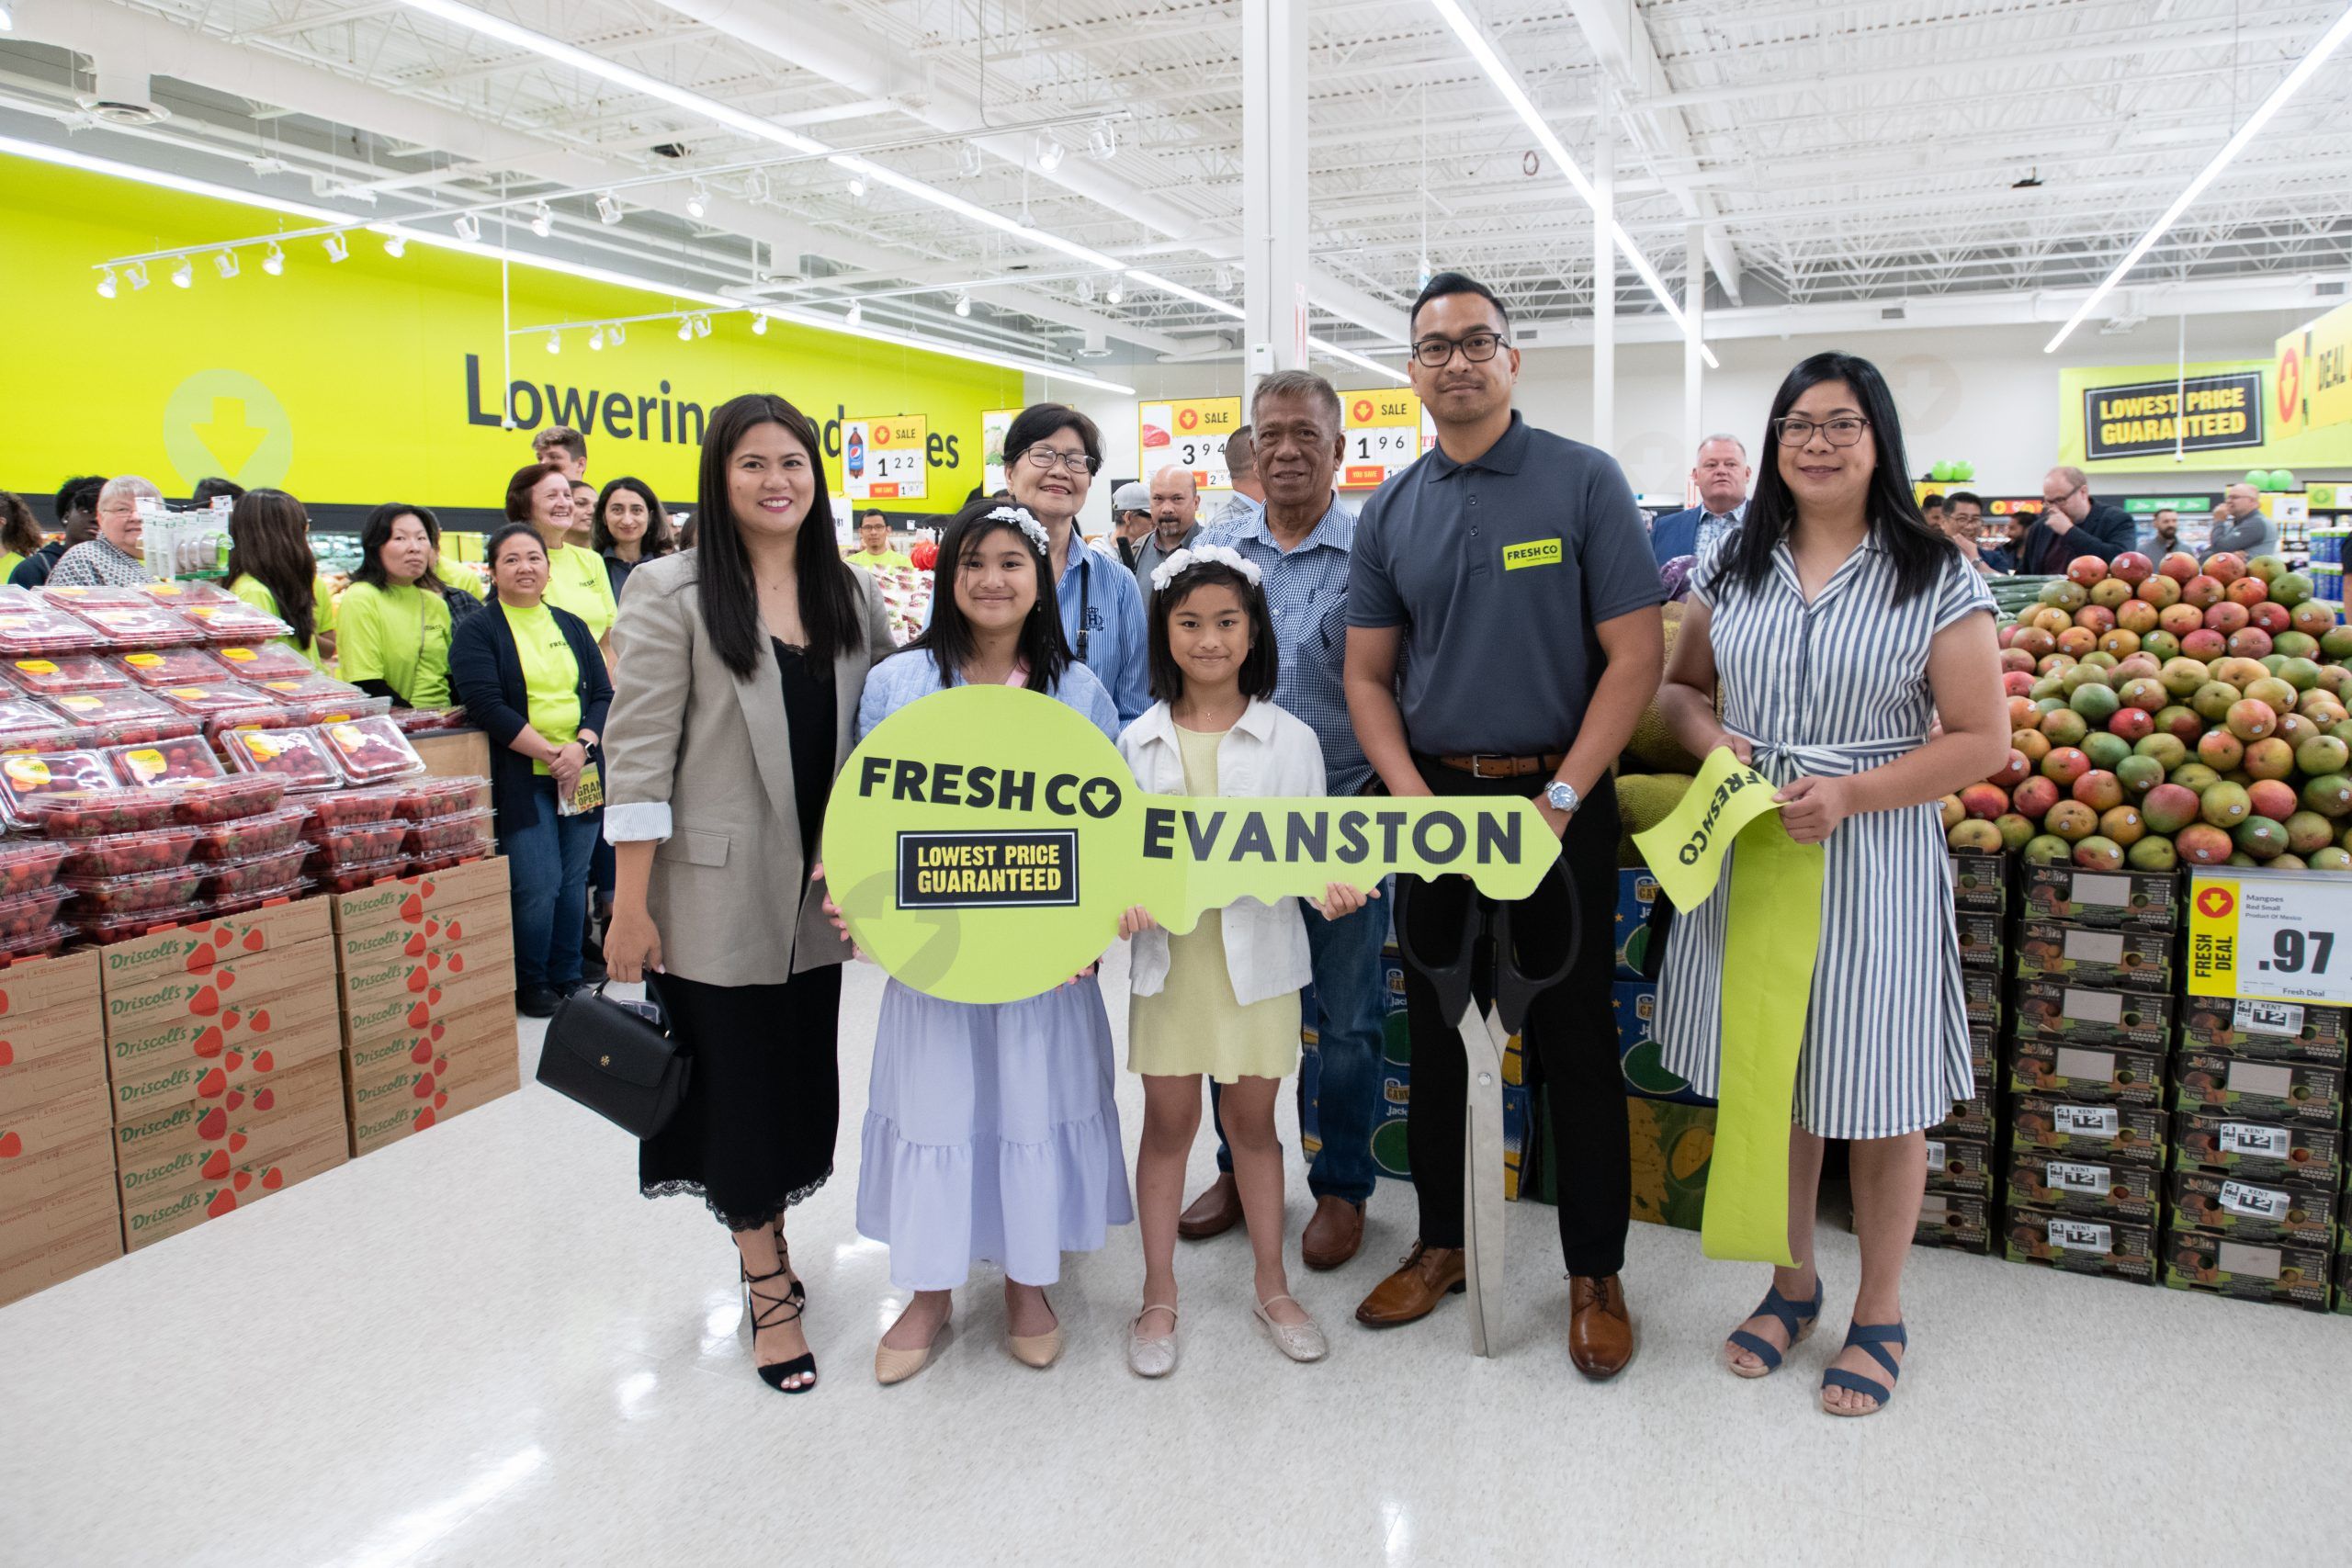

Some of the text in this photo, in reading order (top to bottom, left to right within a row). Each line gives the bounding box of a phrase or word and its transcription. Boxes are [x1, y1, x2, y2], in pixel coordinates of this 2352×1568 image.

[465, 353, 719, 446] Lowerin
[1382, 403, 1407, 415] SALE
[2099, 387, 2245, 420] LOWEST PRICE
[1205, 412, 1228, 423] SALE
[896, 429, 916, 439] SALE
[1143, 807, 1521, 864] EVANSTON
[918, 844, 1060, 867] LOWEST PRICE
[918, 868, 1061, 893] GUARANTEED
[343, 891, 395, 916] Driscoll's
[2245, 895, 2284, 903] Mangoes
[108, 940, 180, 969] Driscoll's
[347, 930, 399, 954] Driscoll's
[2215, 936, 2233, 971] DEAL
[2258, 929, 2335, 975] .97
[2195, 934, 2211, 977] FRESH
[349, 964, 401, 990] Driscoll's
[110, 985, 182, 1015] Driscoll's
[2282, 987, 2304, 996] Fresh
[353, 1001, 402, 1029] Driscoll's
[2255, 1010, 2285, 1024] 12
[2261, 1002, 2282, 1010] KENT
[115, 1027, 187, 1058] Driscoll's
[355, 1038, 405, 1066] Driscoll's
[119, 1070, 190, 1102] Driscoll's
[356, 1073, 409, 1102] Driscoll's
[119, 1109, 191, 1143] Driscoll's
[358, 1108, 409, 1139] Driscoll's
[2074, 1115, 2102, 1126] 12
[2240, 1134, 2270, 1145] 12
[124, 1153, 194, 1189] Driscoll's
[2067, 1173, 2094, 1183] 12
[2240, 1195, 2272, 1209] 12
[2247, 1189, 2269, 1199] KENT
[131, 1192, 199, 1230] Driscoll's
[2068, 1232, 2096, 1242] 12
